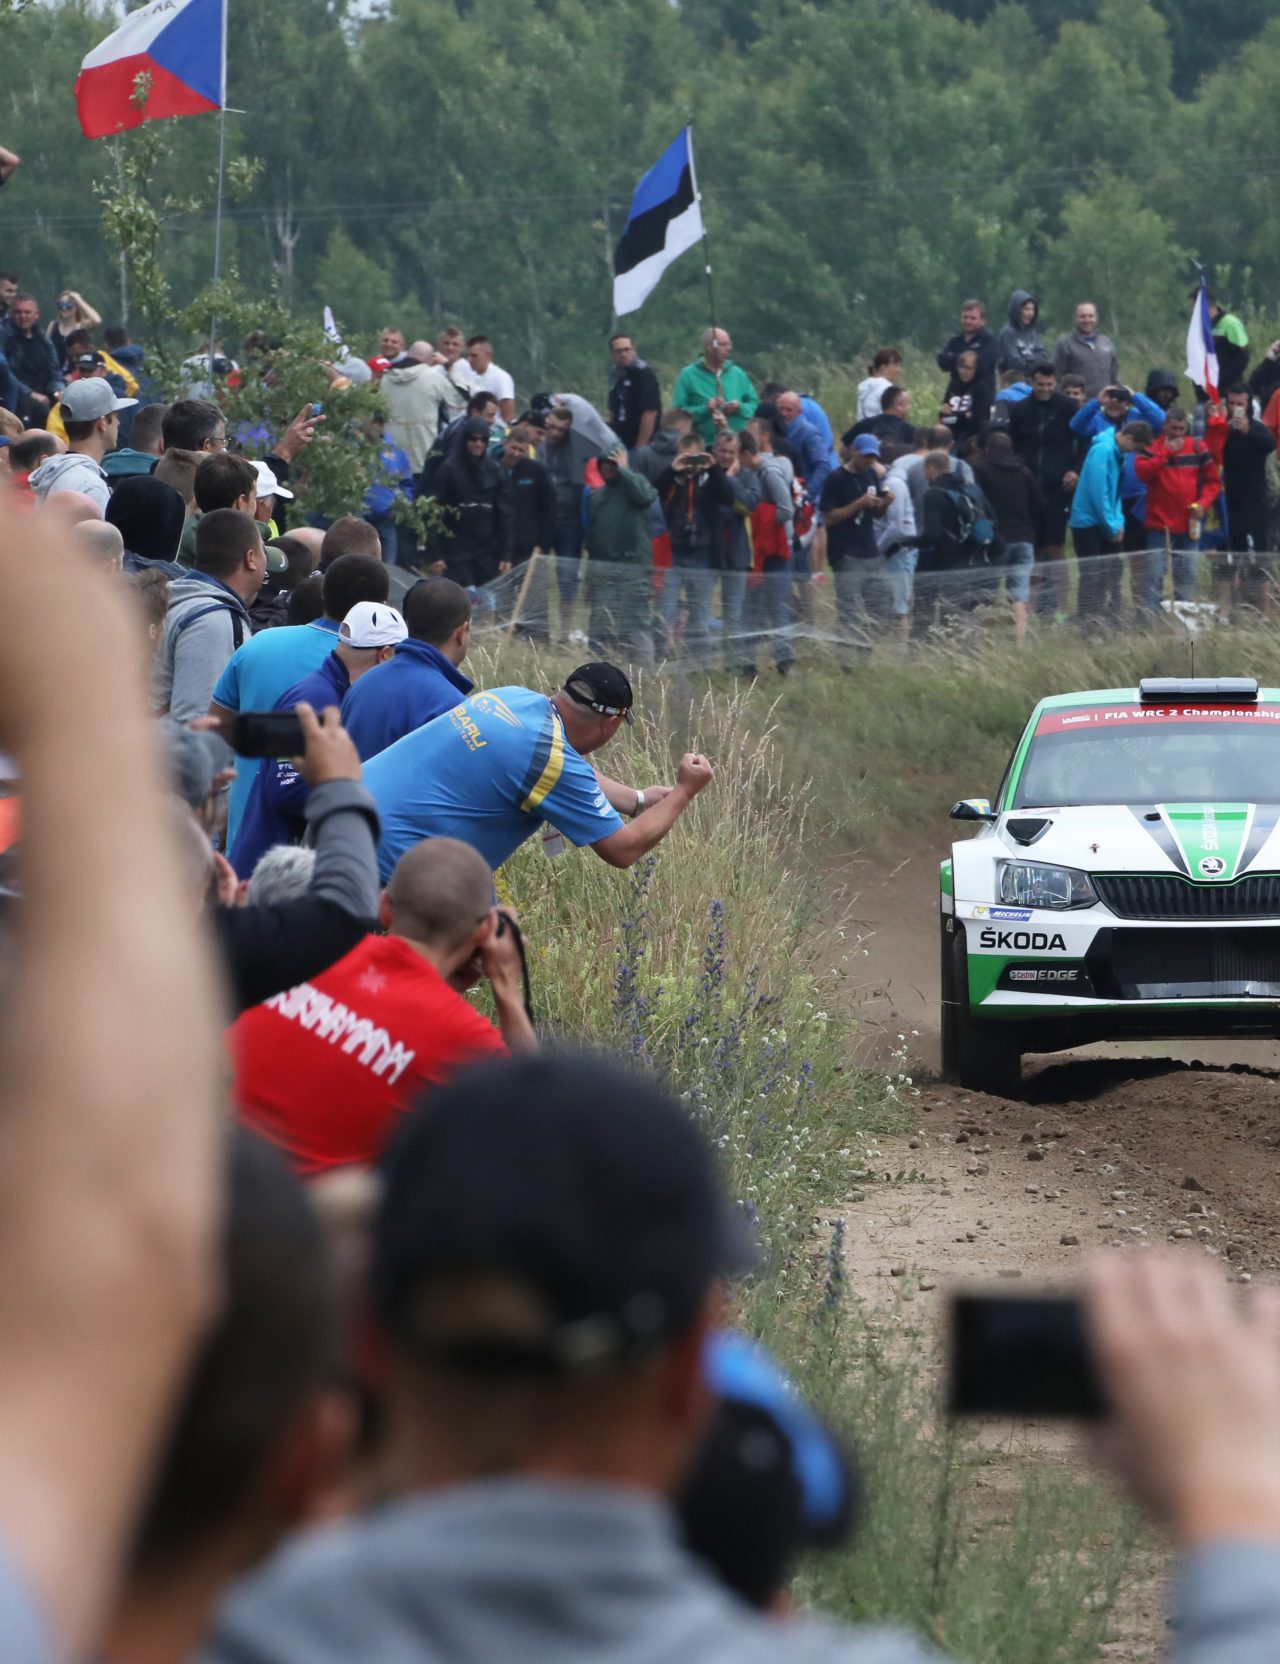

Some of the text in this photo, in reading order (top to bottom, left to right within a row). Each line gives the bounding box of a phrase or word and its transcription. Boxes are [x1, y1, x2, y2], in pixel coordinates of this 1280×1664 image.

[1104, 711, 1129, 720] FIA
[1132, 709, 1165, 718] WRC
[453, 705, 488, 748] BARU
[993, 910, 1032, 919] MICHELIN
[980, 927, 1067, 951] ŠKODA
[1016, 969, 1079, 981] Castrol EDGE
